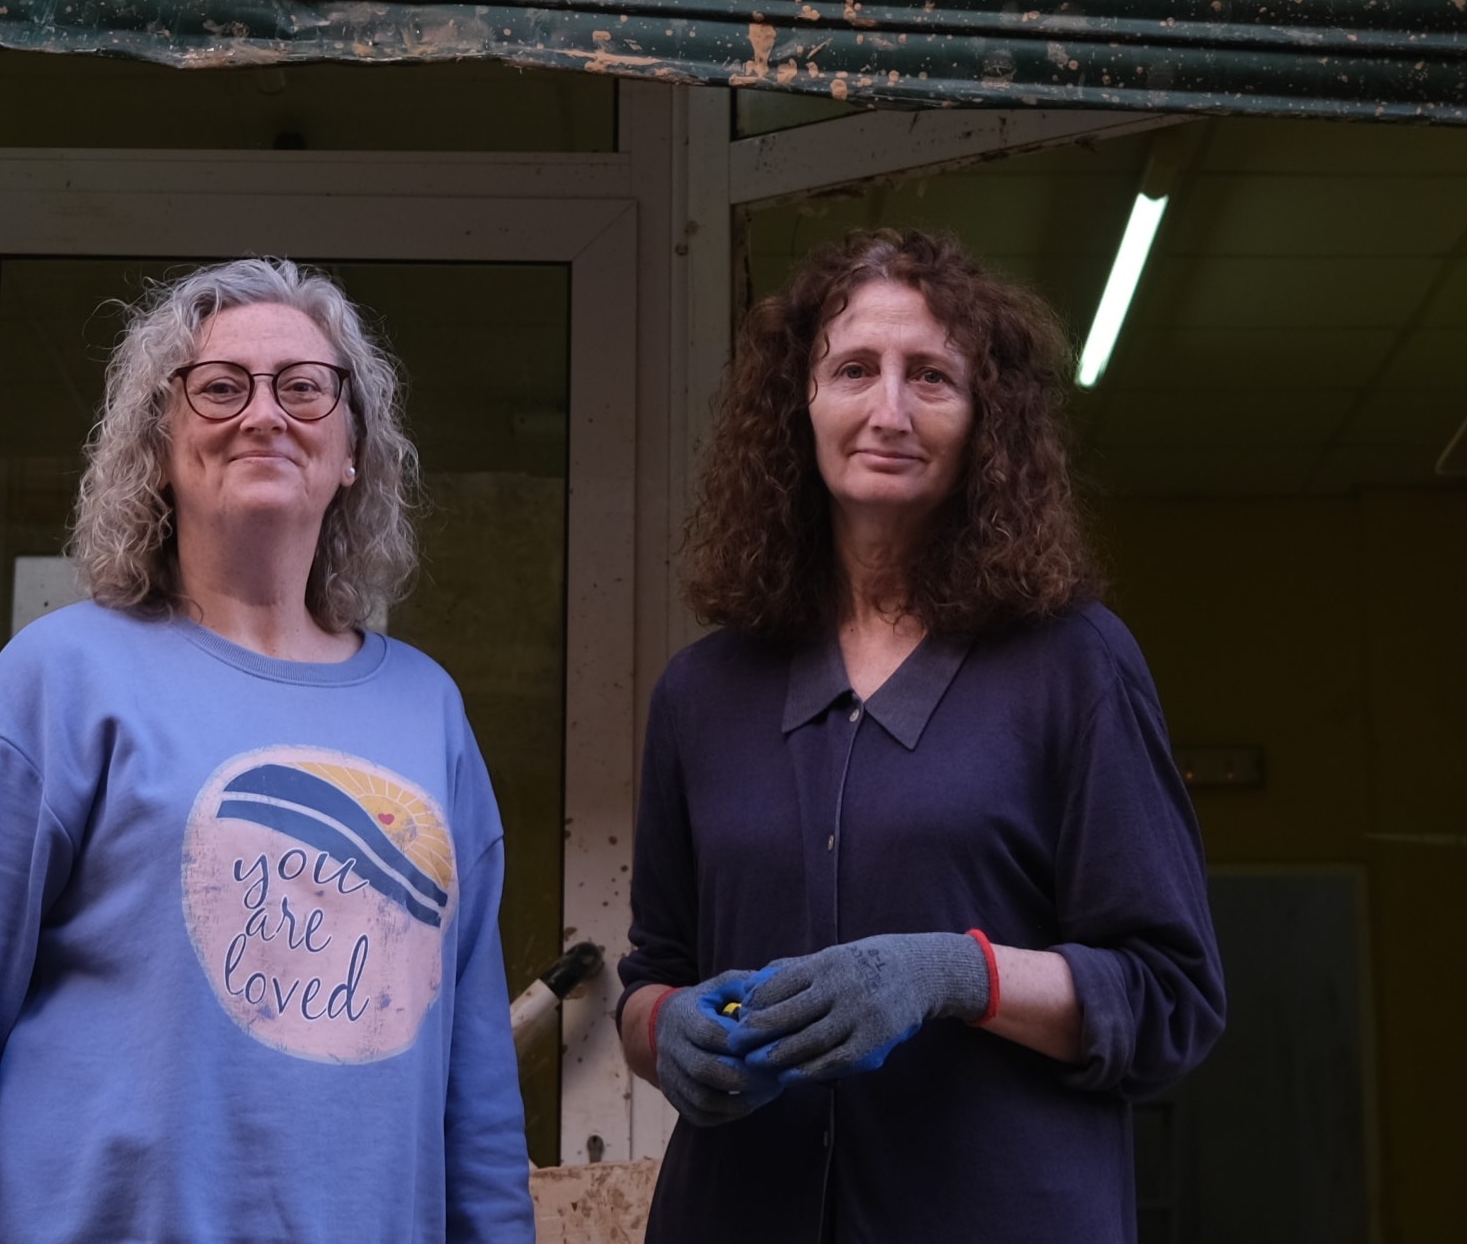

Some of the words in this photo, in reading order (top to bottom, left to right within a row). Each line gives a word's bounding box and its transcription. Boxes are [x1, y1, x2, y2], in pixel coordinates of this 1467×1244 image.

[233, 848, 369, 909] you
[245, 896, 332, 953] are
[223, 933, 370, 1022] loved
